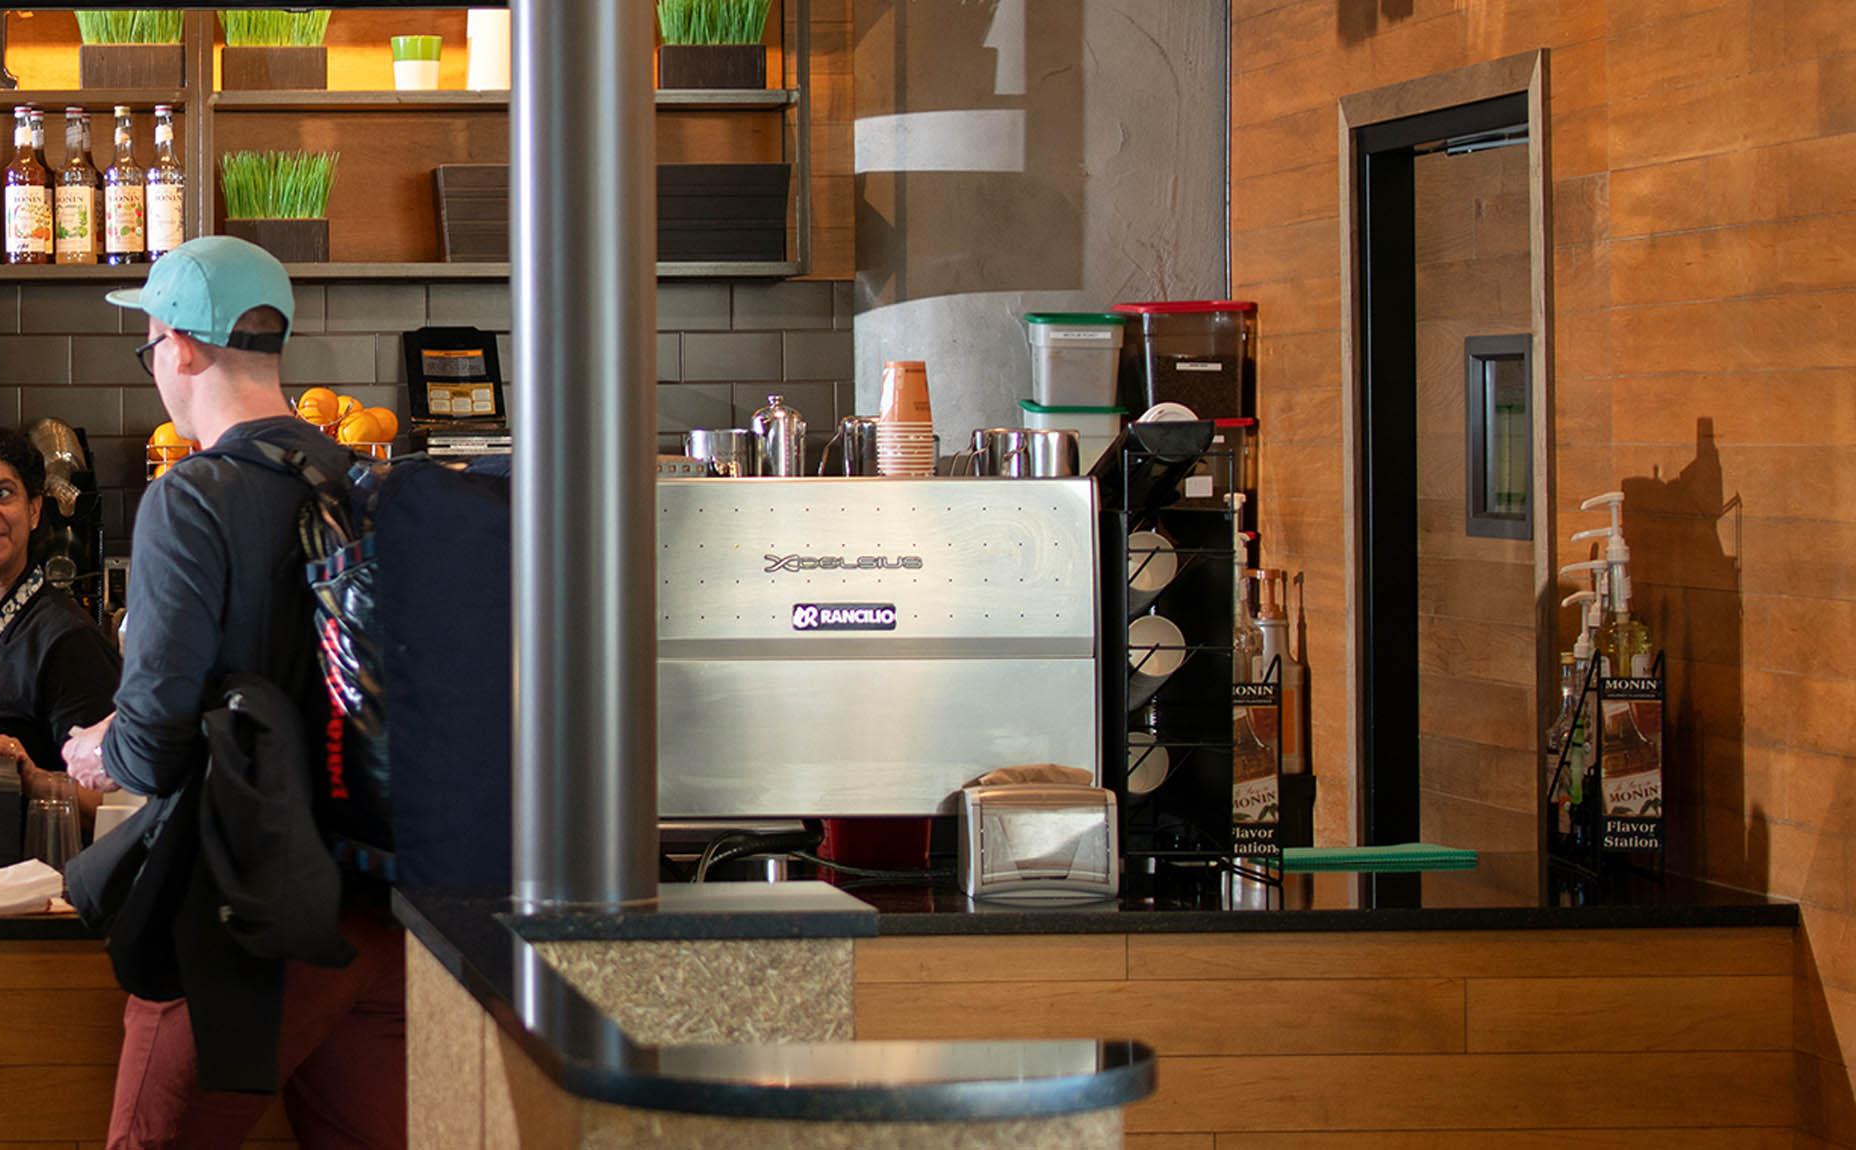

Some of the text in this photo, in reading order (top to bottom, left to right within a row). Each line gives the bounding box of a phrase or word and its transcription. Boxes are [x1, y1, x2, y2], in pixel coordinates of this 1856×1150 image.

[820, 609, 894, 624] RANCILIO
[1233, 684, 1274, 696] ONIN
[1605, 679, 1657, 690] MONIN
[1610, 787, 1659, 803] MONIN
[1607, 820, 1657, 834] Flavor
[1233, 842, 1276, 854] tation
[1603, 835, 1659, 849] Station
